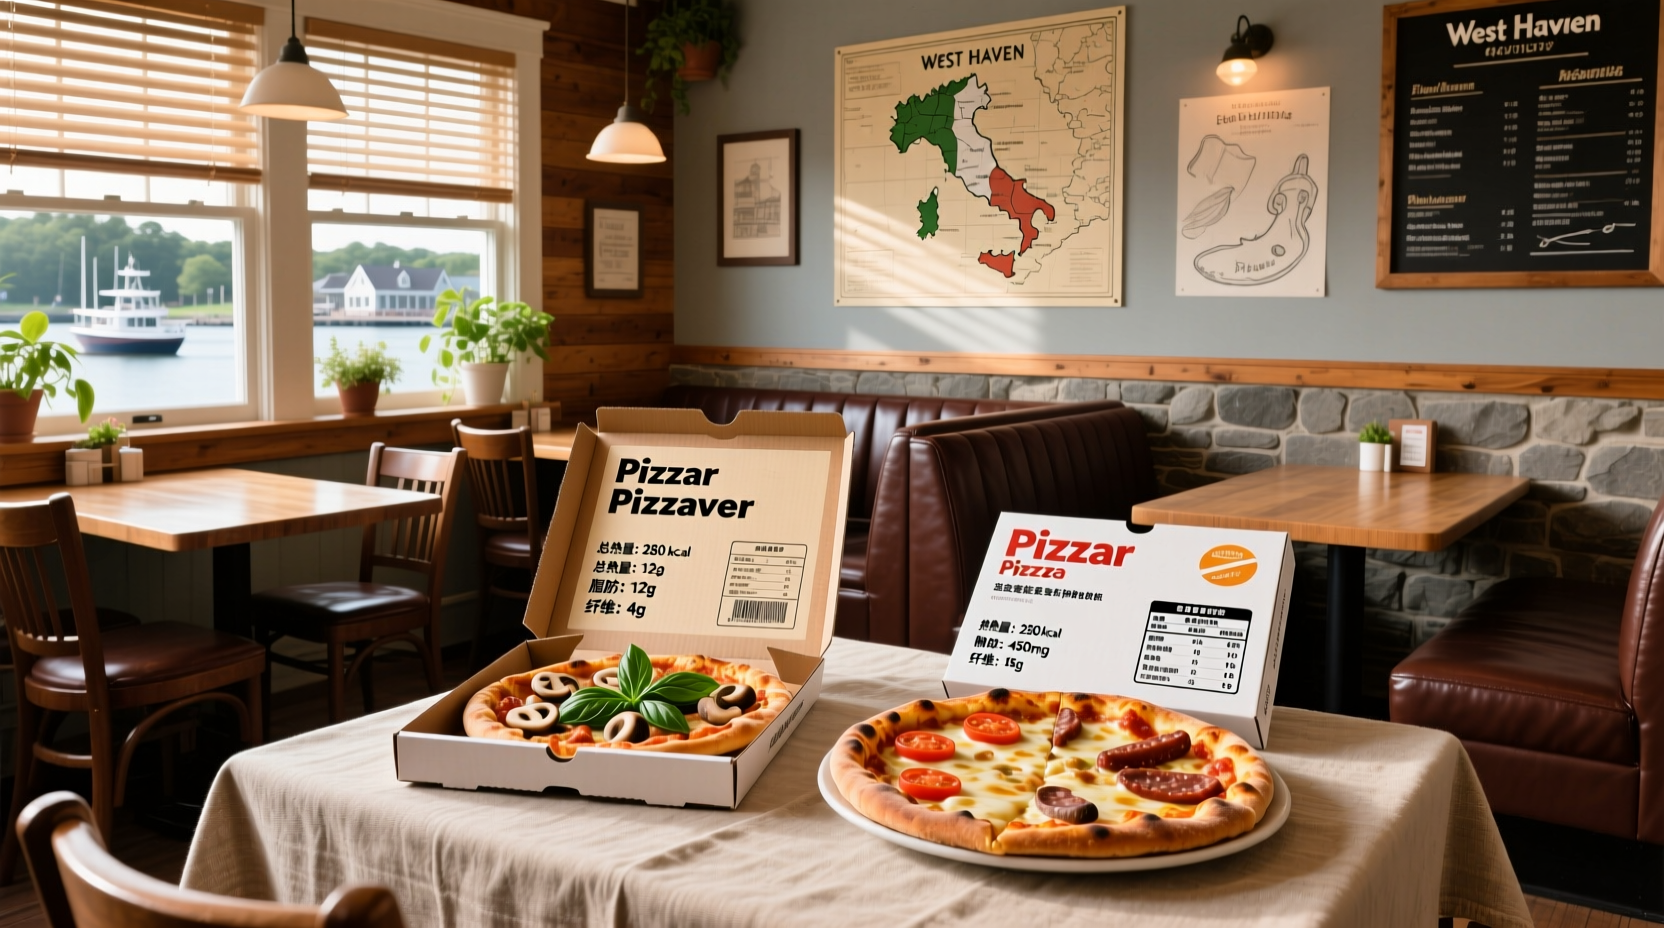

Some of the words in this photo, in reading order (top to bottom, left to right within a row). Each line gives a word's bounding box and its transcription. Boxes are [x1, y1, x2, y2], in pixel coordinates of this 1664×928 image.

[1446, 18, 1507, 47] West
[921, 50, 963, 70] WEST
[969, 44, 1025, 65] HAVEN
[615, 457, 719, 486] Pizzar
[608, 488, 755, 518] Pizzaver
[667, 545, 691, 557] kcal
[1005, 528, 1135, 568] Pizzar
[641, 562, 665, 577] 12g
[998, 559, 1066, 580] Pizzza
[630, 581, 656, 598] 12g
[627, 601, 646, 619] 4g
[1007, 640, 1050, 659] 450mg
